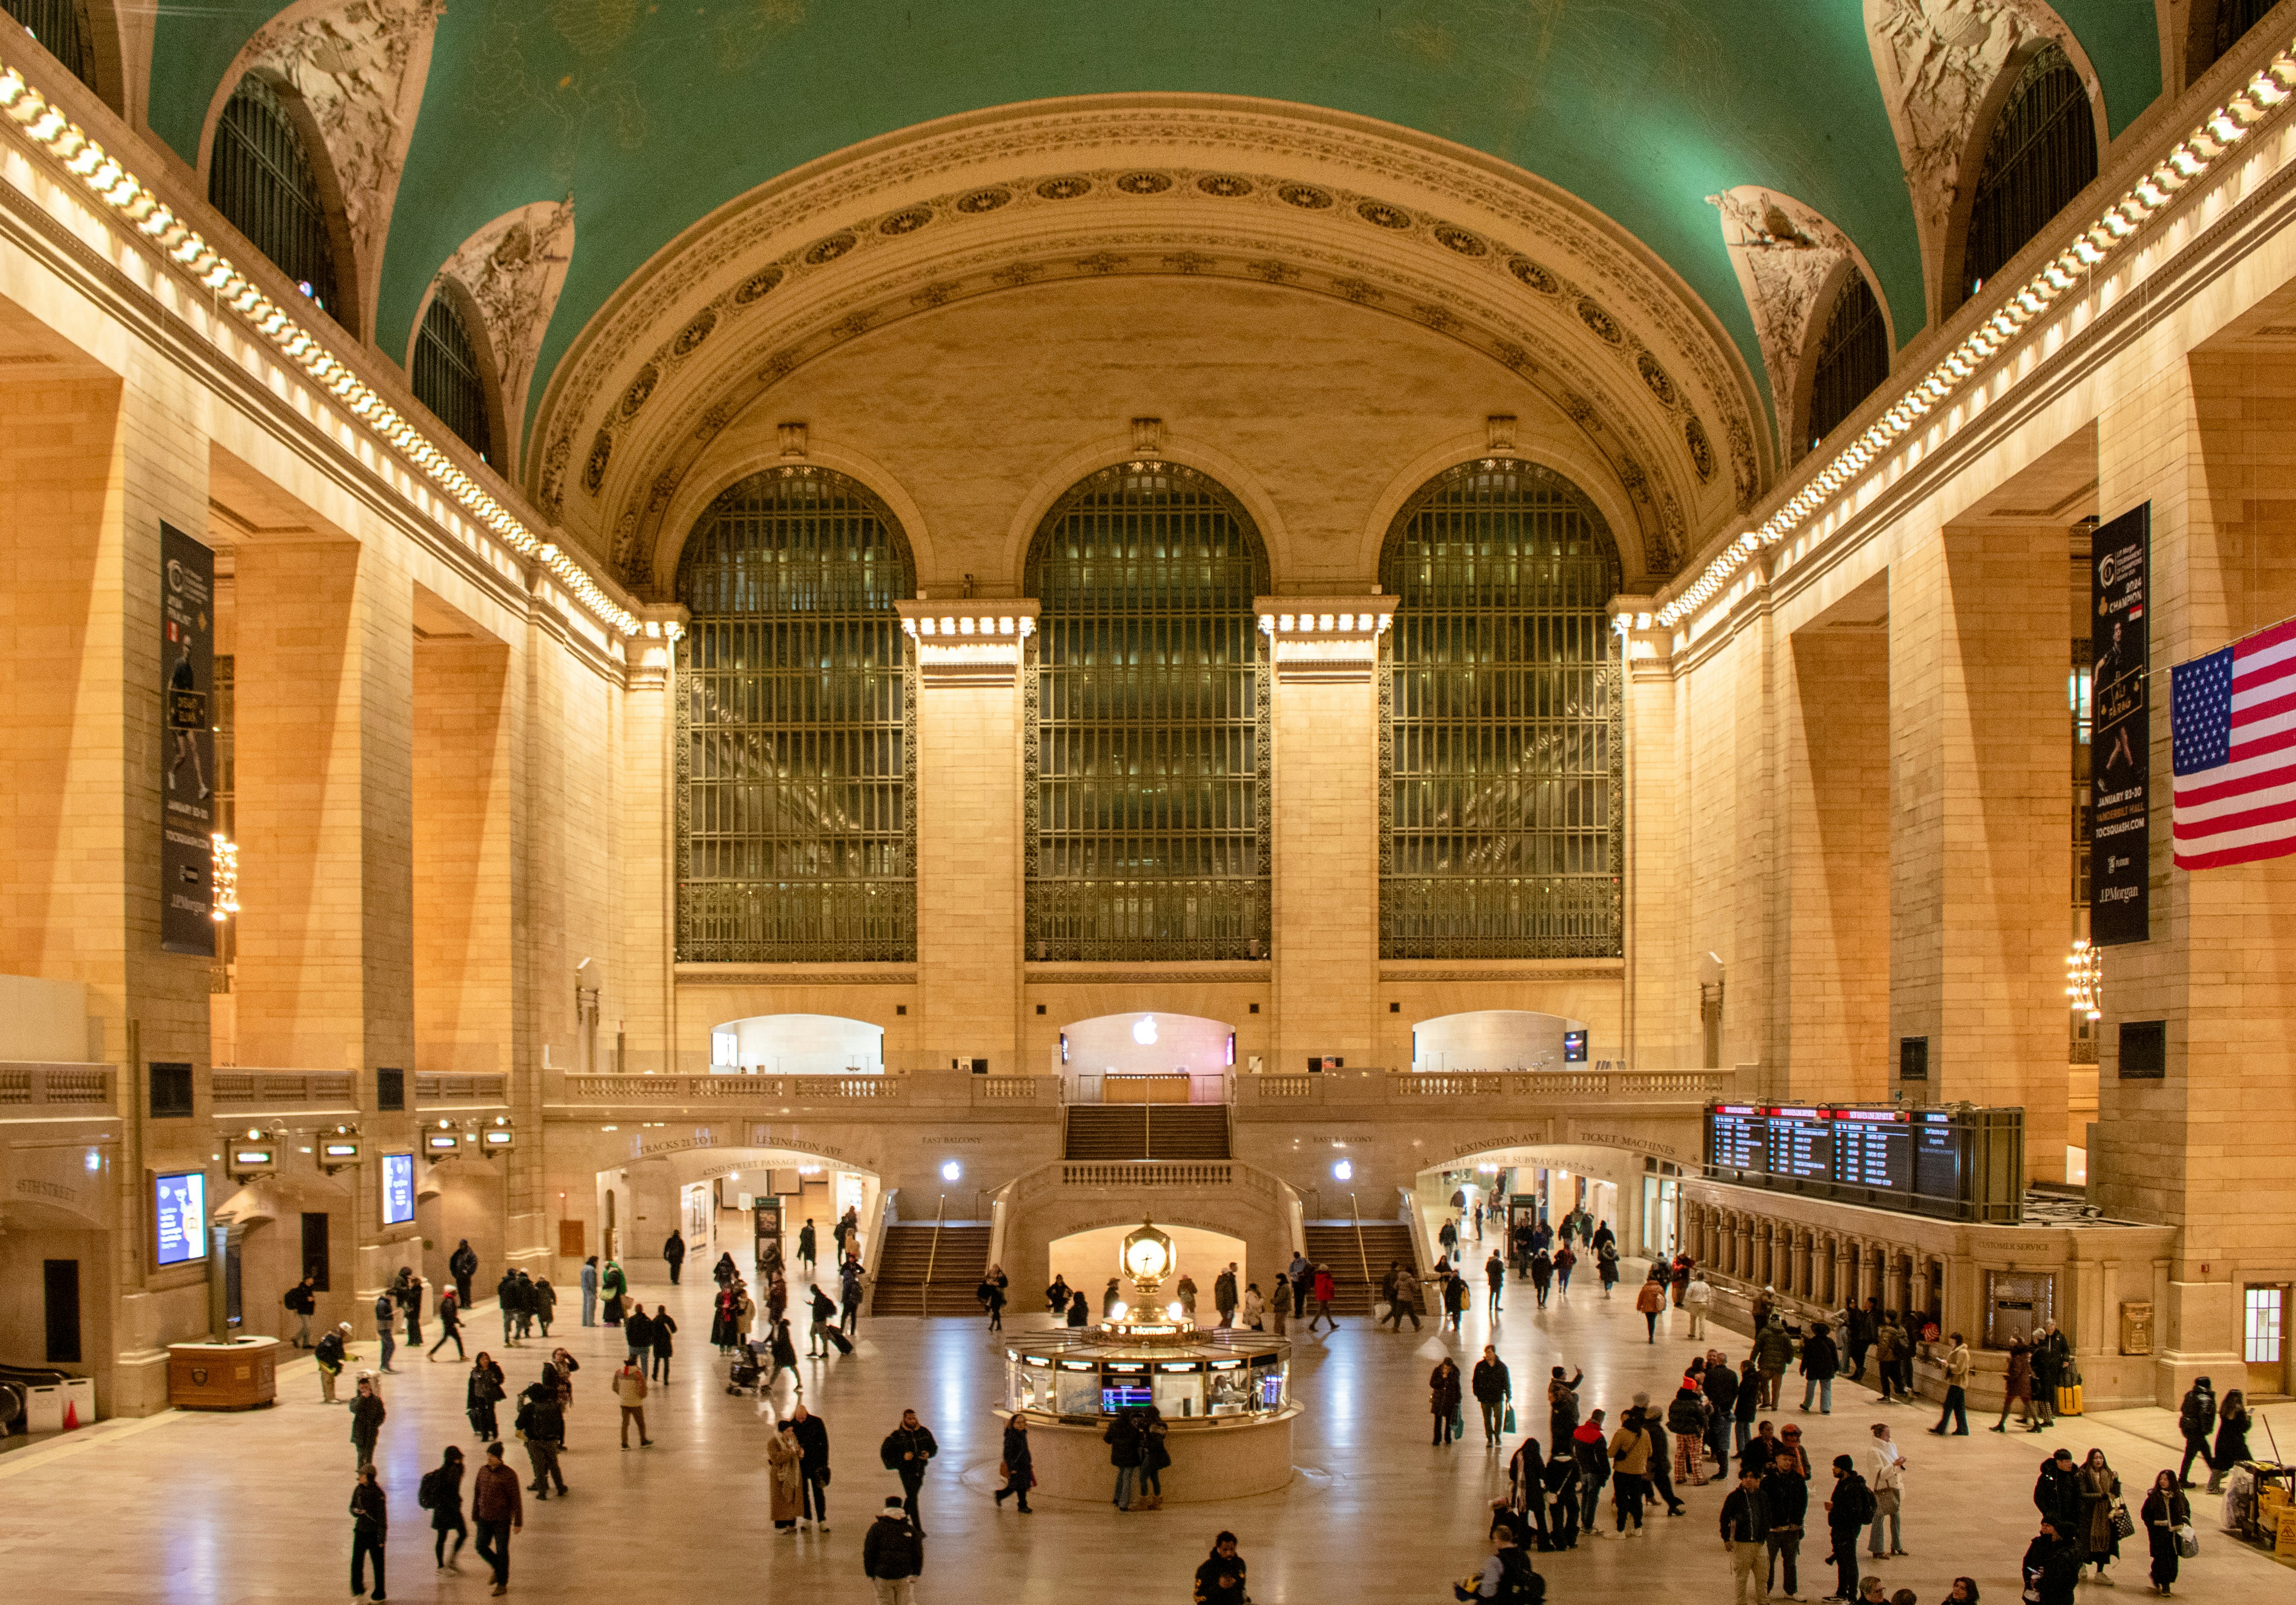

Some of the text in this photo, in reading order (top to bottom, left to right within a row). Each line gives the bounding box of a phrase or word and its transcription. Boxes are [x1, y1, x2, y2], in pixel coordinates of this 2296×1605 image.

[2126, 576, 2142, 594] 2024
[2109, 589, 2142, 613] CHAMPION
[2097, 791, 2124, 808] JANUARY
[2096, 817, 2145, 839] TOCSQUASH.COM
[640, 1140, 679, 1154] TRACKS
[692, 1136, 708, 1145] TO
[756, 1136, 843, 1157] LEXINGTON AVE
[1454, 1133, 1541, 1155] LEXINGTON AVE
[1581, 1133, 1676, 1155] TICKET MACHINES
[703, 1165, 725, 1175] 42ND
[727, 1161, 758, 1171] STREET
[1469, 1156, 1508, 1165] PASSAGE
[1512, 1156, 1552, 1165] SUBWAY
[1169, 1216, 1240, 1236] DINING CONCOURSE
[1979, 1241, 2015, 1250] CUSTOMER
[1130, 1325, 1177, 1335] Information
